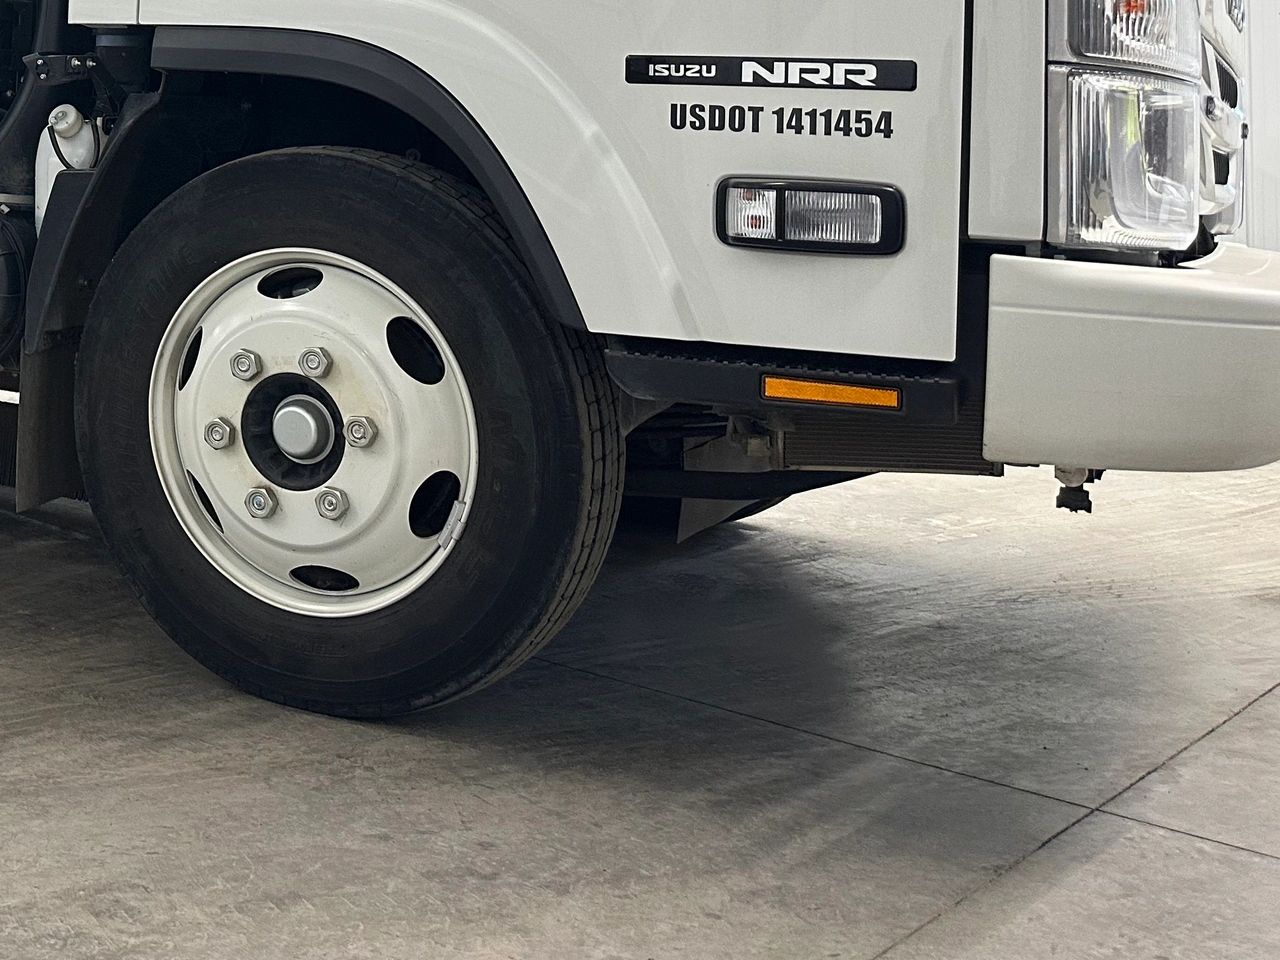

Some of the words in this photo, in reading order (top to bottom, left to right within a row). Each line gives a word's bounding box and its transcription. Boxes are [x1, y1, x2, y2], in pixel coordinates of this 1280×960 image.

[648, 63, 717, 78] ISUZU
[741, 61, 877, 87] NRR
[670, 103, 765, 133] USDOT
[771, 107, 894, 139] 1411454
